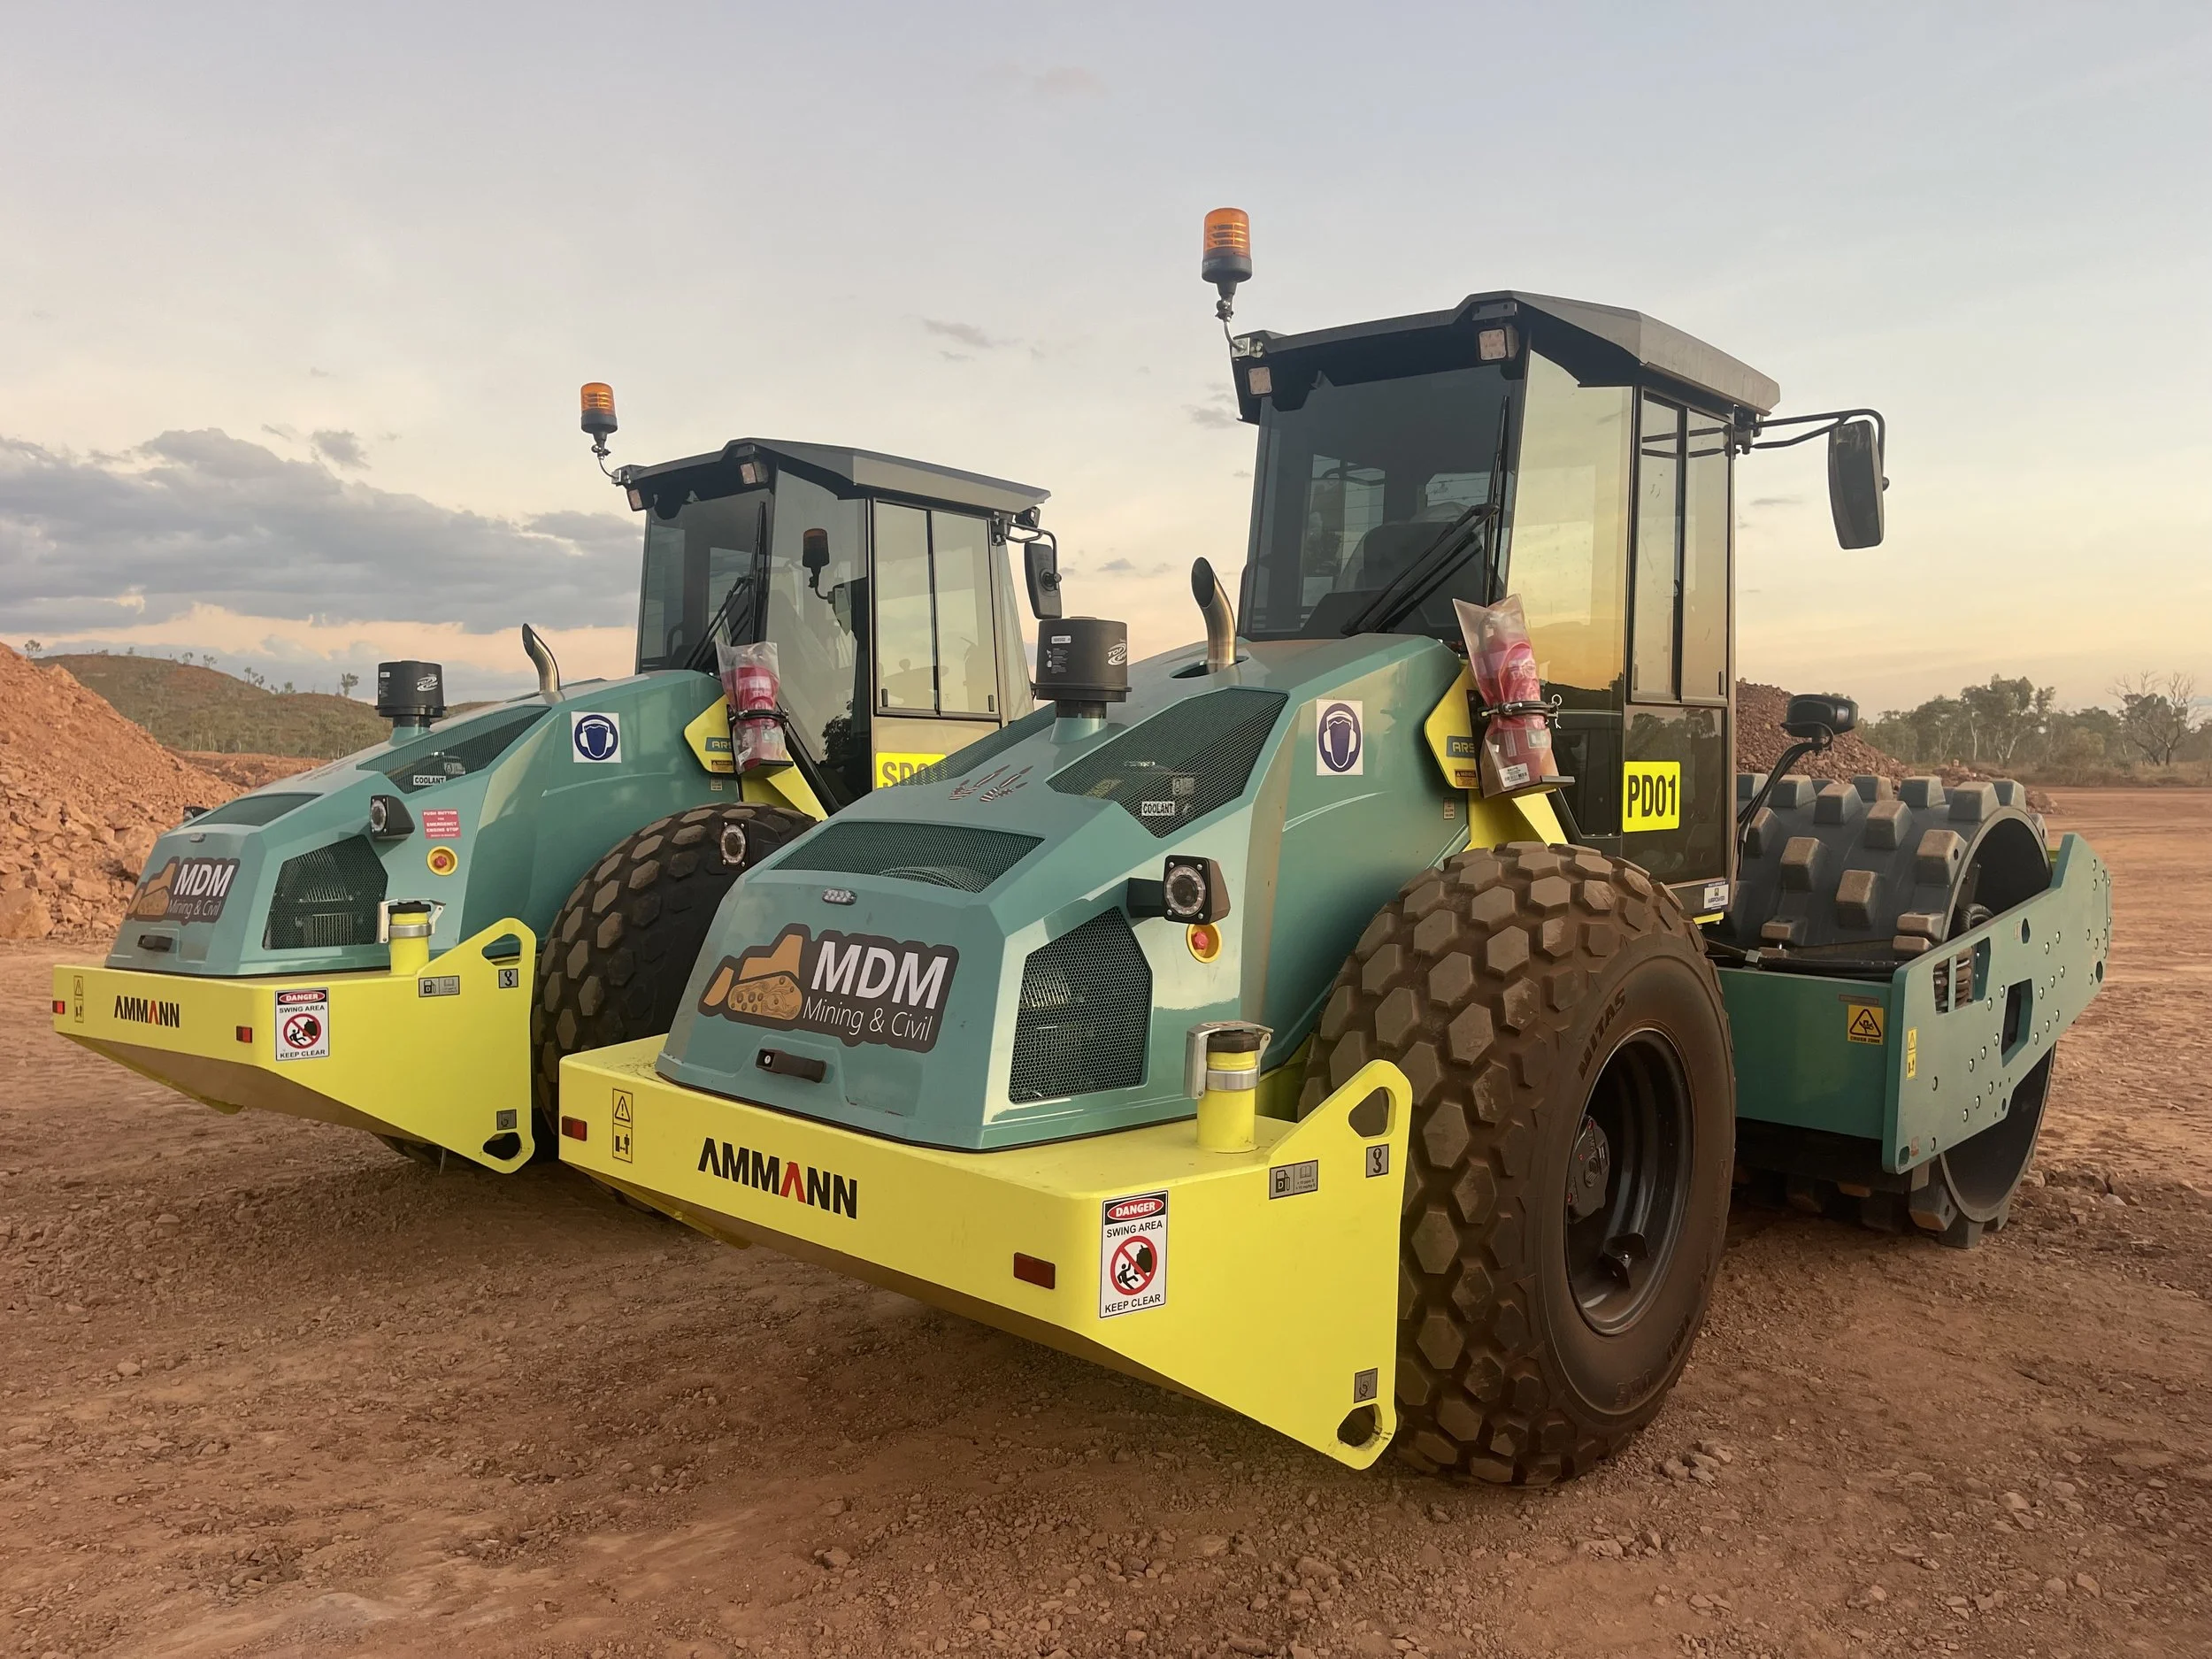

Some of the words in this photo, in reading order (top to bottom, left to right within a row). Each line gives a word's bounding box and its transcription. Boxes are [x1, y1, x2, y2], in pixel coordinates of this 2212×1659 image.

[882, 761, 929, 787] SD
[1142, 803, 1173, 814] COOLANT
[1627, 774, 1676, 818] PD01
[173, 864, 235, 897] MDM
[167, 899, 193, 919] Mining
[194, 899, 202, 916] &
[202, 900, 222, 917] Civil
[810, 941, 949, 1010] MDM
[285, 993, 319, 1002] DANGER
[113, 995, 180, 1028] AMMANN
[803, 996, 864, 1035] Mining
[869, 1007, 885, 1033] &
[891, 1011, 933, 1041] Civil
[1578, 987, 1625, 1080] MITAS
[697, 1137, 857, 1220] AMMANN
[1278, 1180, 1284, 1190] D
[1115, 1202, 1156, 1217] DANGER
[1106, 1225, 1137, 1238] SWING
[1138, 1220, 1163, 1233] AREA
[1104, 1300, 1129, 1314] KEEP
[1131, 1294, 1161, 1308] CLEAR
